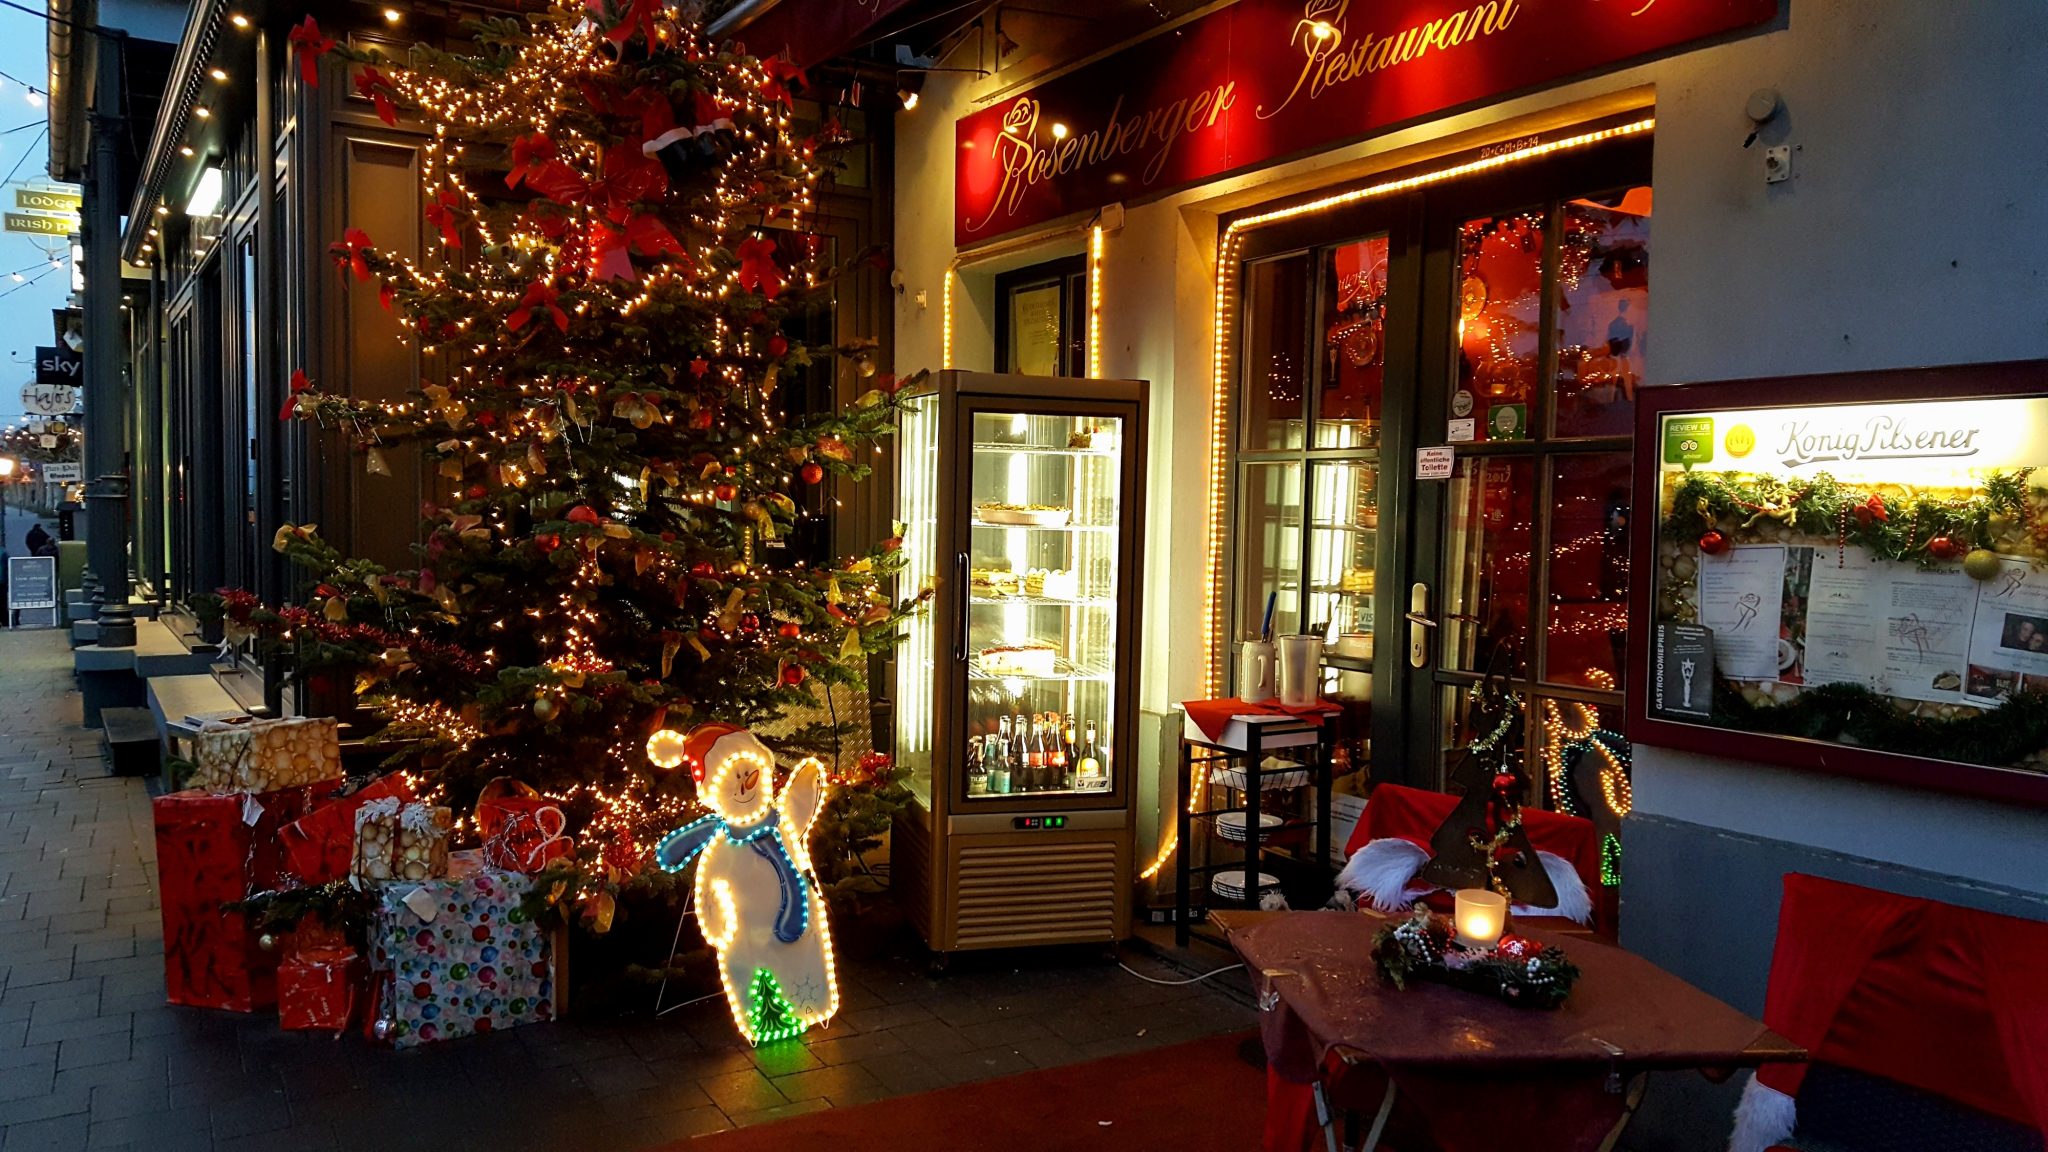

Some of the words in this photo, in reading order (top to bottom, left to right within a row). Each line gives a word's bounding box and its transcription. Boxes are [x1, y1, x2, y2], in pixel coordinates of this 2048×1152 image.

[966, 81, 1236, 232] Rosenberger
[1256, 0, 1520, 119] Restaurant
[22, 195, 77, 208] LODGE
[42, 355, 80, 376] sky
[1670, 424, 1698, 432] REVIEW
[1700, 423, 1711, 431] US
[1860, 415, 1980, 453] Pilsener
[1361, 613, 1374, 622] VIS
[1656, 624, 1665, 710] GASTRONOMIEPREIS
